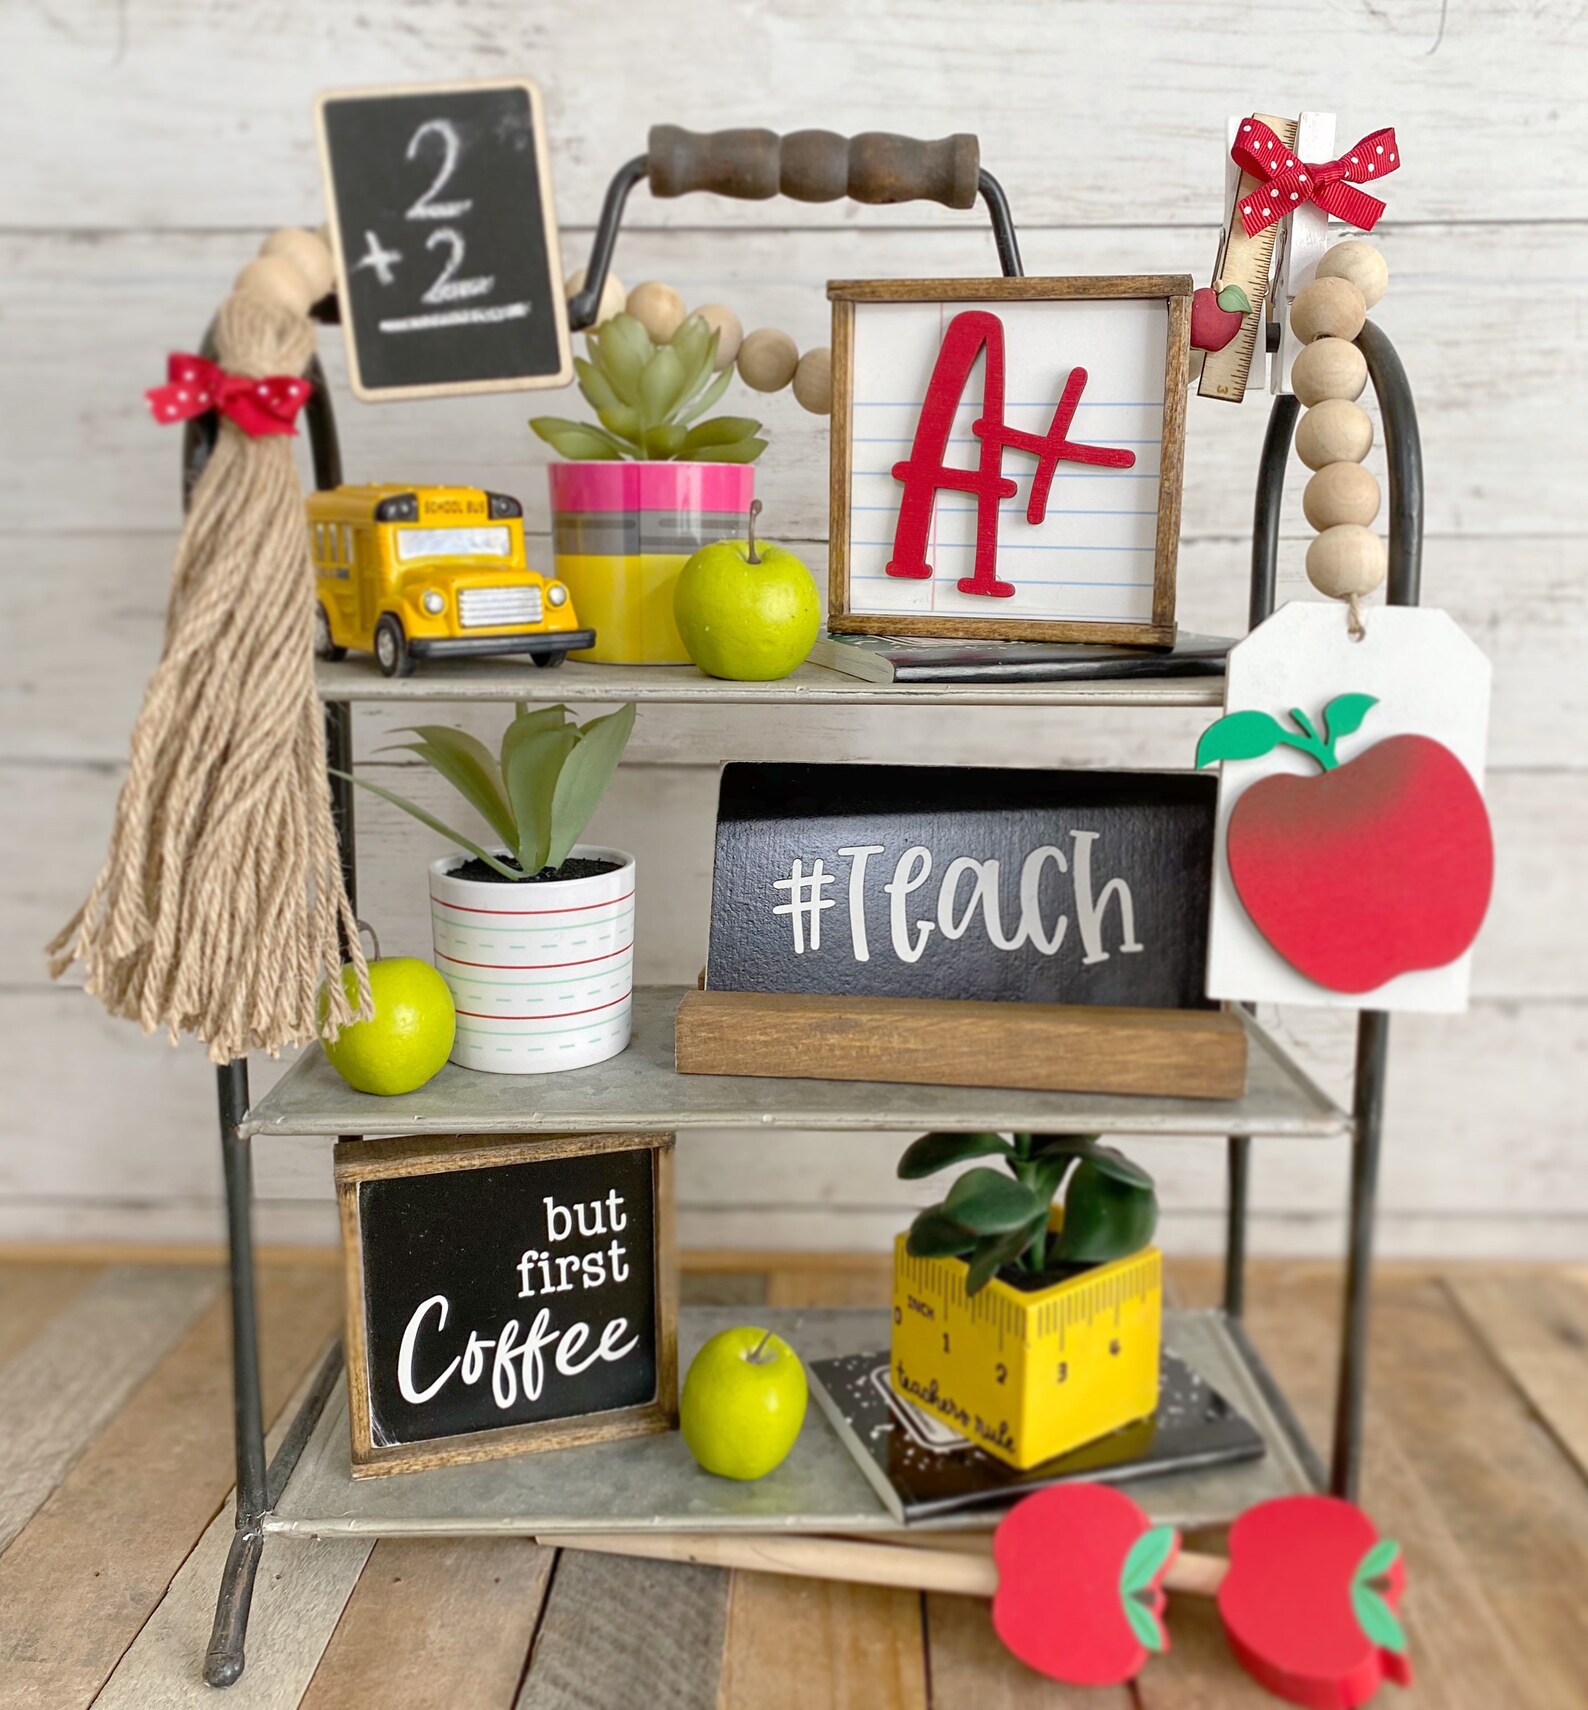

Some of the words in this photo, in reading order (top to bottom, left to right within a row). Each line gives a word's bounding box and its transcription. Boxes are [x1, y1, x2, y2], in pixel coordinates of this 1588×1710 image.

[405, 119, 473, 220] 2
[421, 227, 495, 304] 2
[885, 310, 1136, 598] A+
[424, 499, 463, 515] SCHOOL
[466, 499, 486, 514] BUS
[772, 829, 1144, 965] #Teach
[543, 1188, 627, 1242] but
[516, 1239, 630, 1299] first
[907, 1294, 935, 1321] INCH
[397, 1294, 639, 1410] Coffee
[942, 1332, 950, 1354] 1
[995, 1362, 1008, 1386] 2
[1057, 1361, 1068, 1384] 3
[896, 1358, 971, 1428] teachers
